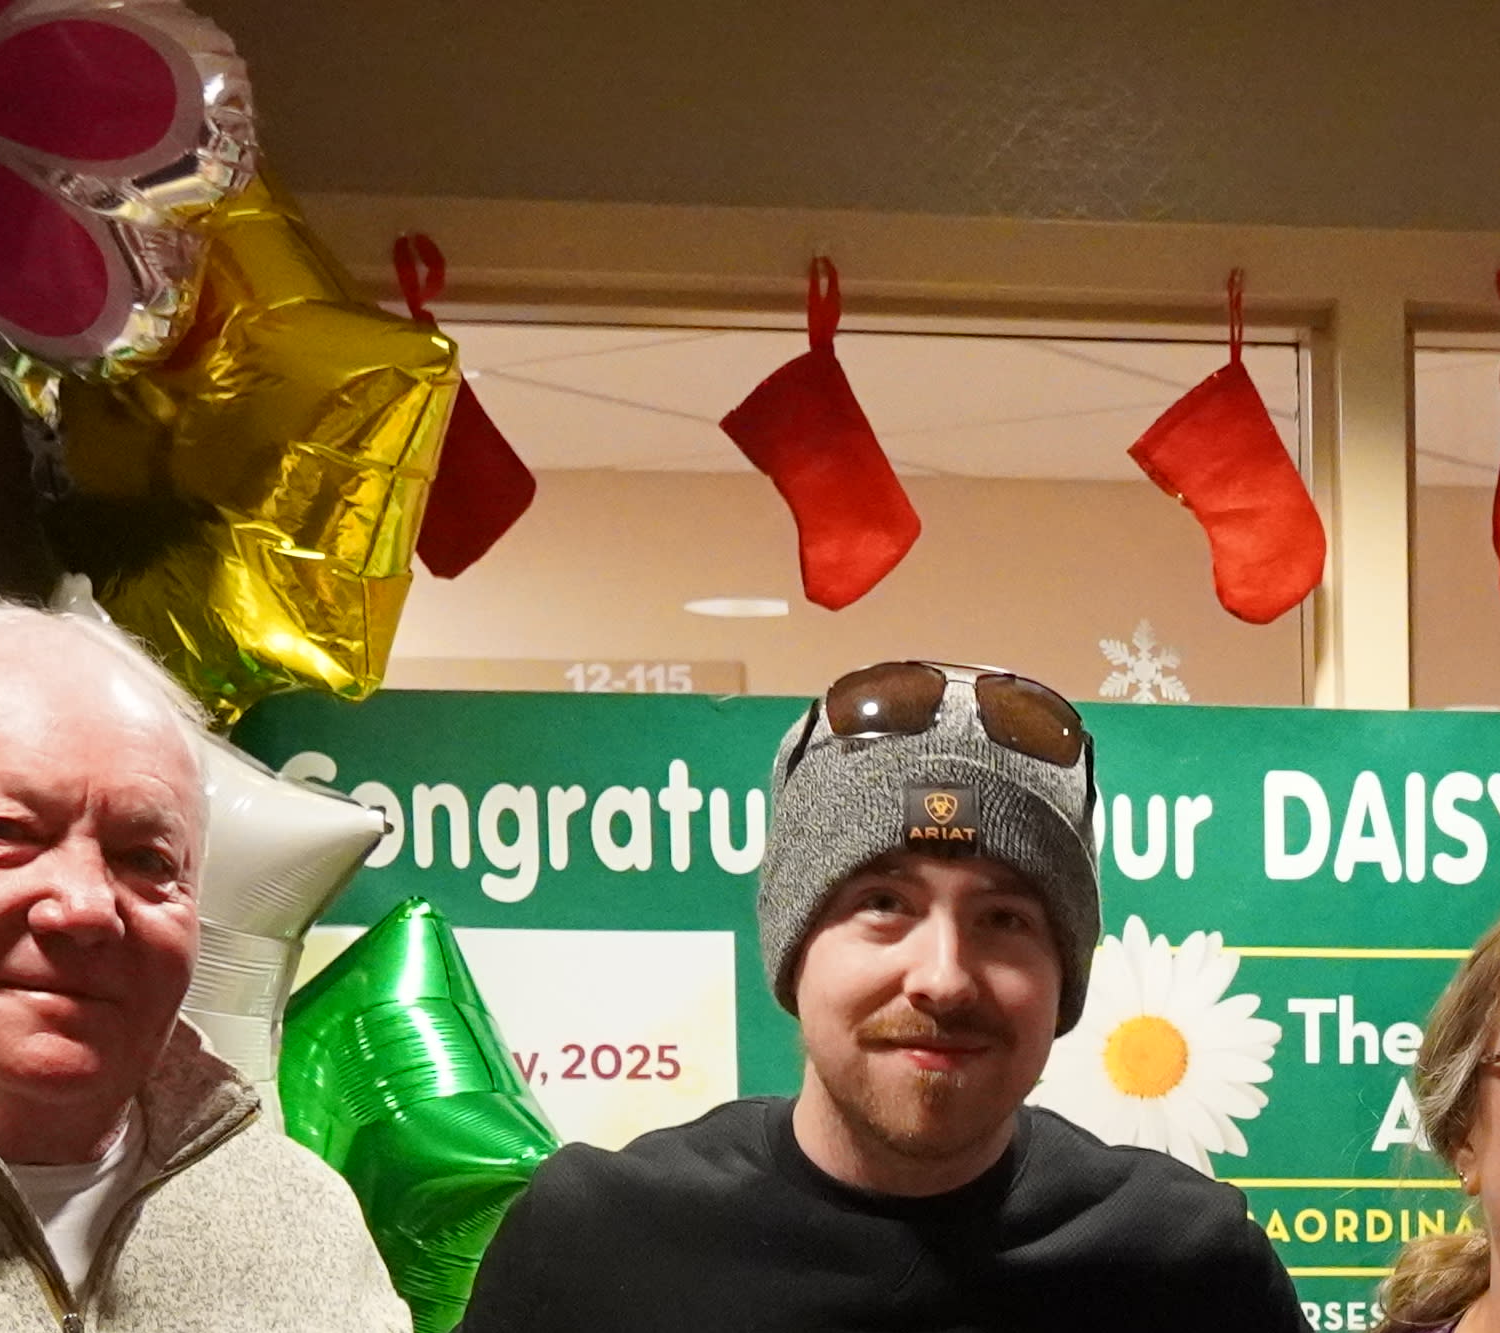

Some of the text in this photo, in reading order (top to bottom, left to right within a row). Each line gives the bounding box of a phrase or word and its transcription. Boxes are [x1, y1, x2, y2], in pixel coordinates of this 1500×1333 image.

[564, 663, 692, 692] 12-115
[910, 826, 976, 840] ARIAT
[1094, 782, 1212, 880] ur
[1288, 995, 1424, 1065] The
[561, 1044, 681, 1081] 2025
[1248, 1208, 1466, 1243] AORDINA
